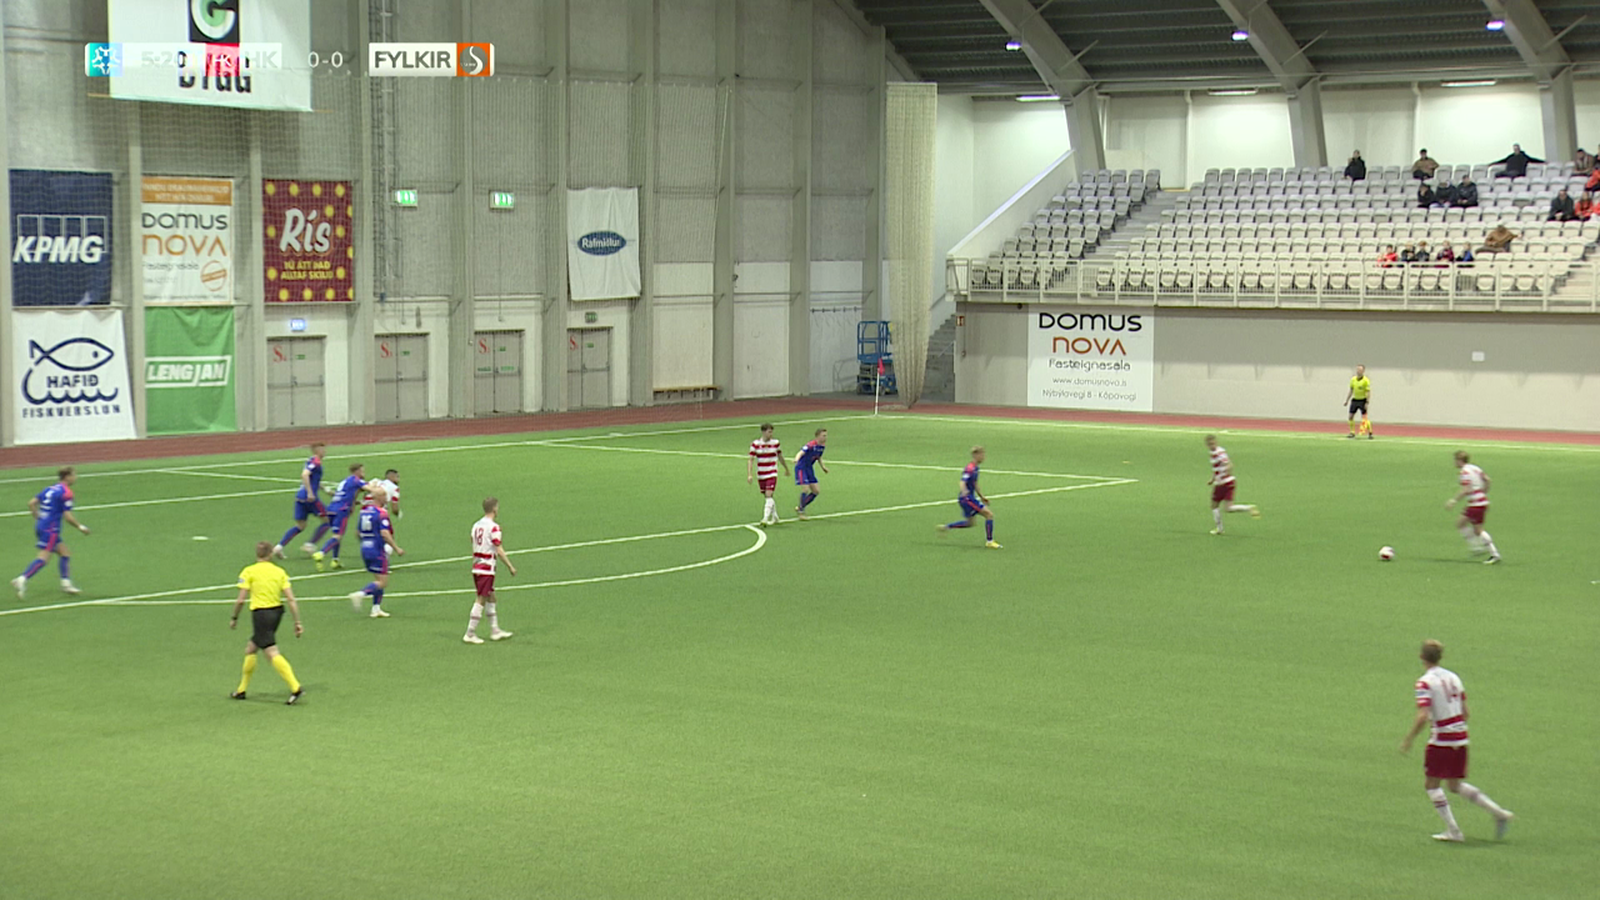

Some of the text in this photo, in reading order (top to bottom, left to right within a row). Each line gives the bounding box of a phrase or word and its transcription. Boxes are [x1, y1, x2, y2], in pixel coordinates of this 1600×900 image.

[280, 208, 331, 252] Rís
[13, 235, 104, 263] KPMG
[148, 363, 225, 382] LENGJAN
[1049, 358, 1131, 372] Fasteignasala
[22, 404, 121, 419] FISKVERSLUN
